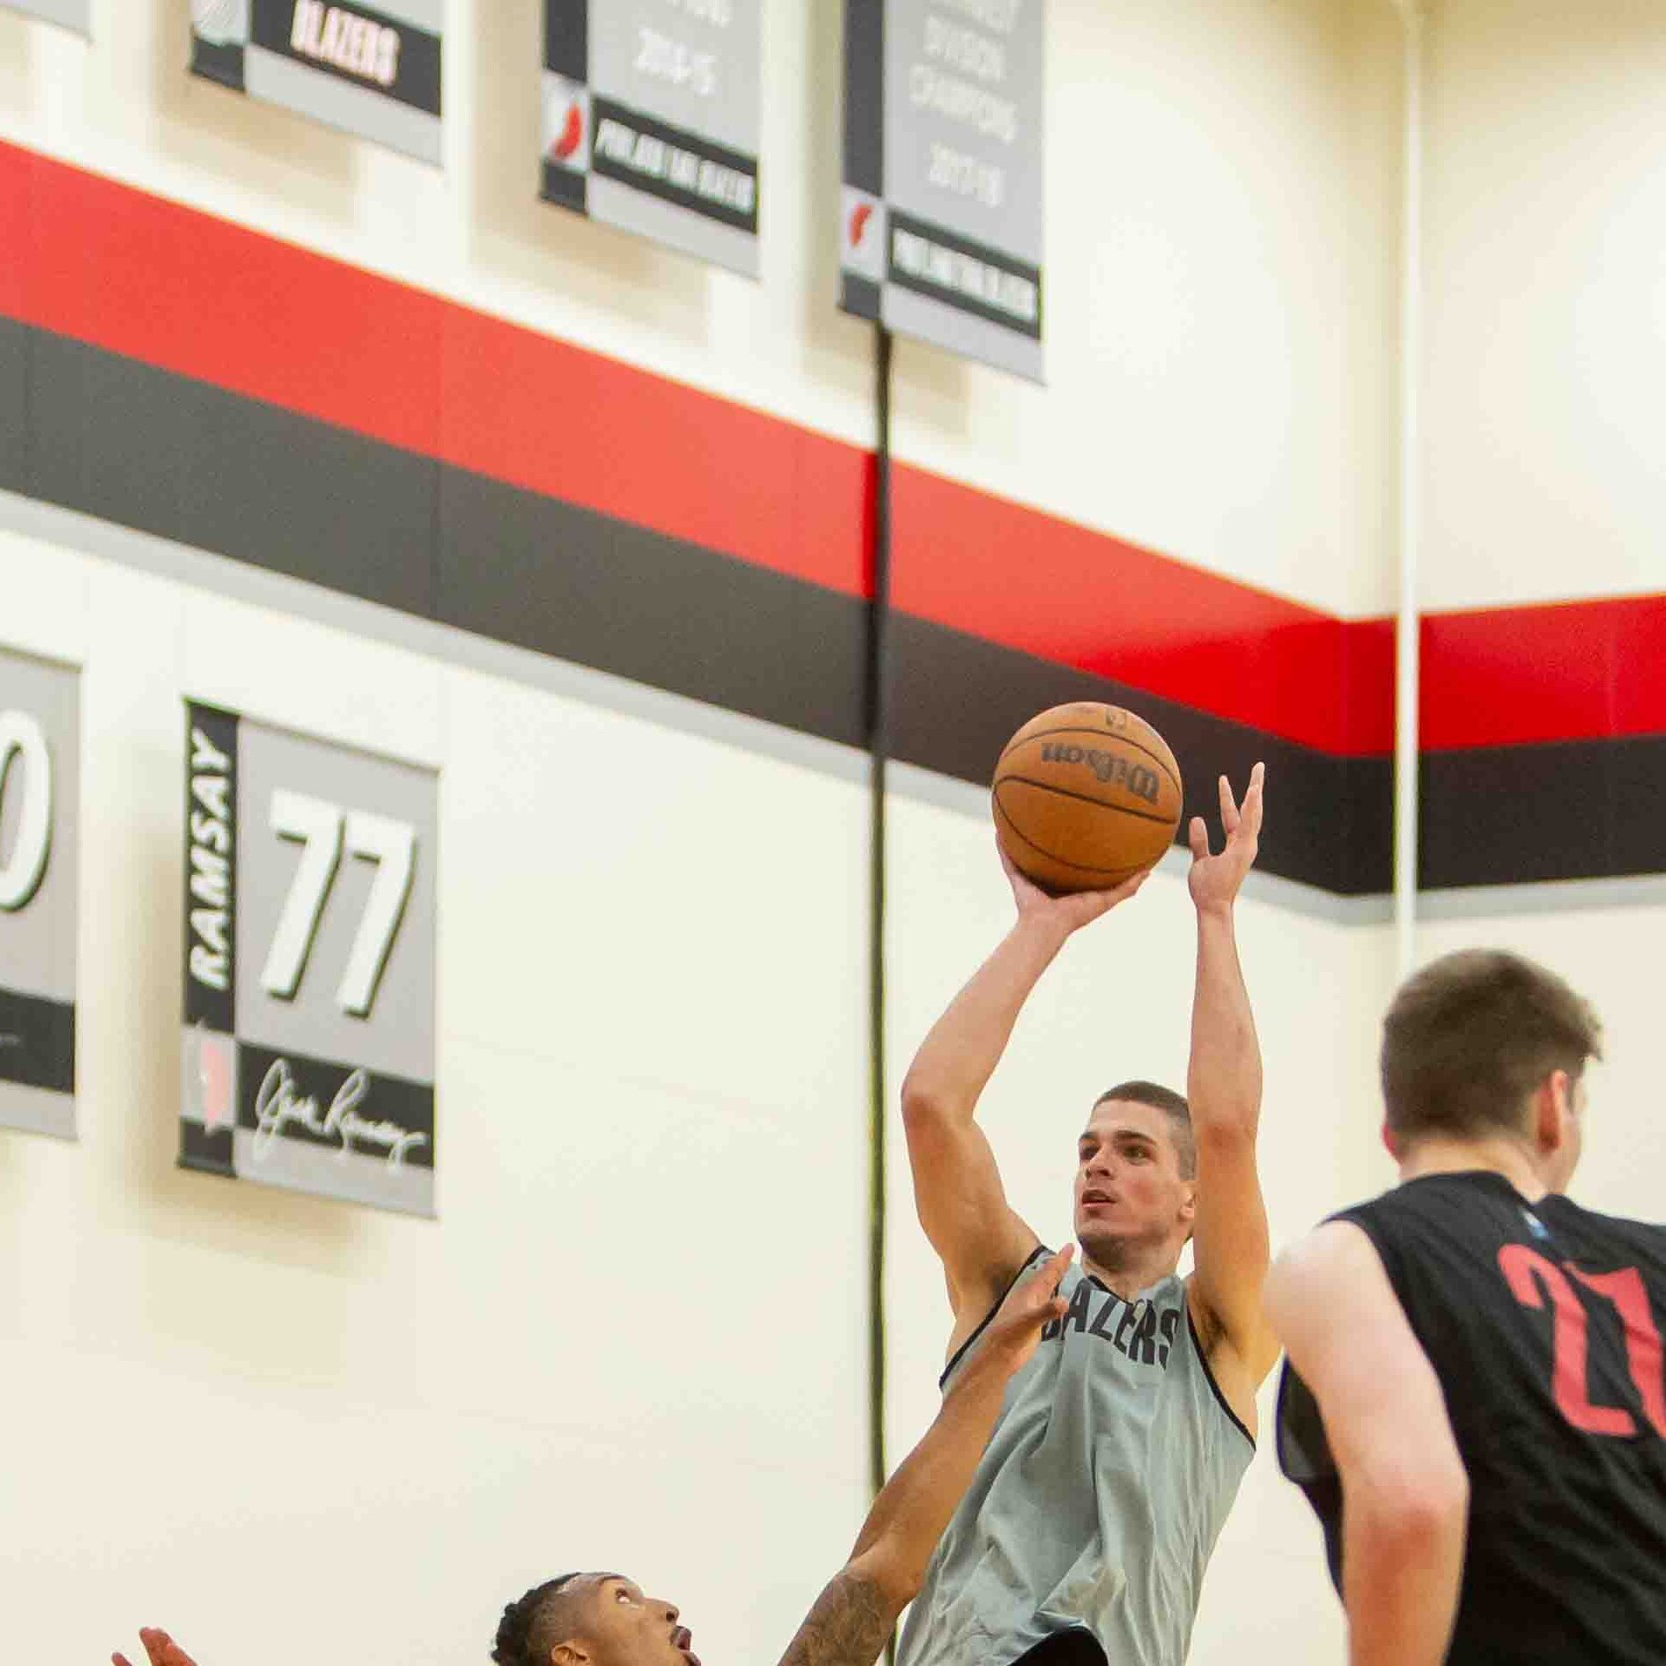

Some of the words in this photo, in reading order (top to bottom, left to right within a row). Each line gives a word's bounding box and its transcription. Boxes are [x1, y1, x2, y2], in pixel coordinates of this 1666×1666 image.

[290, 0, 400, 87] BLAZERS
[188, 728, 231, 990] RAMSAY
[259, 787, 421, 1020] 77
